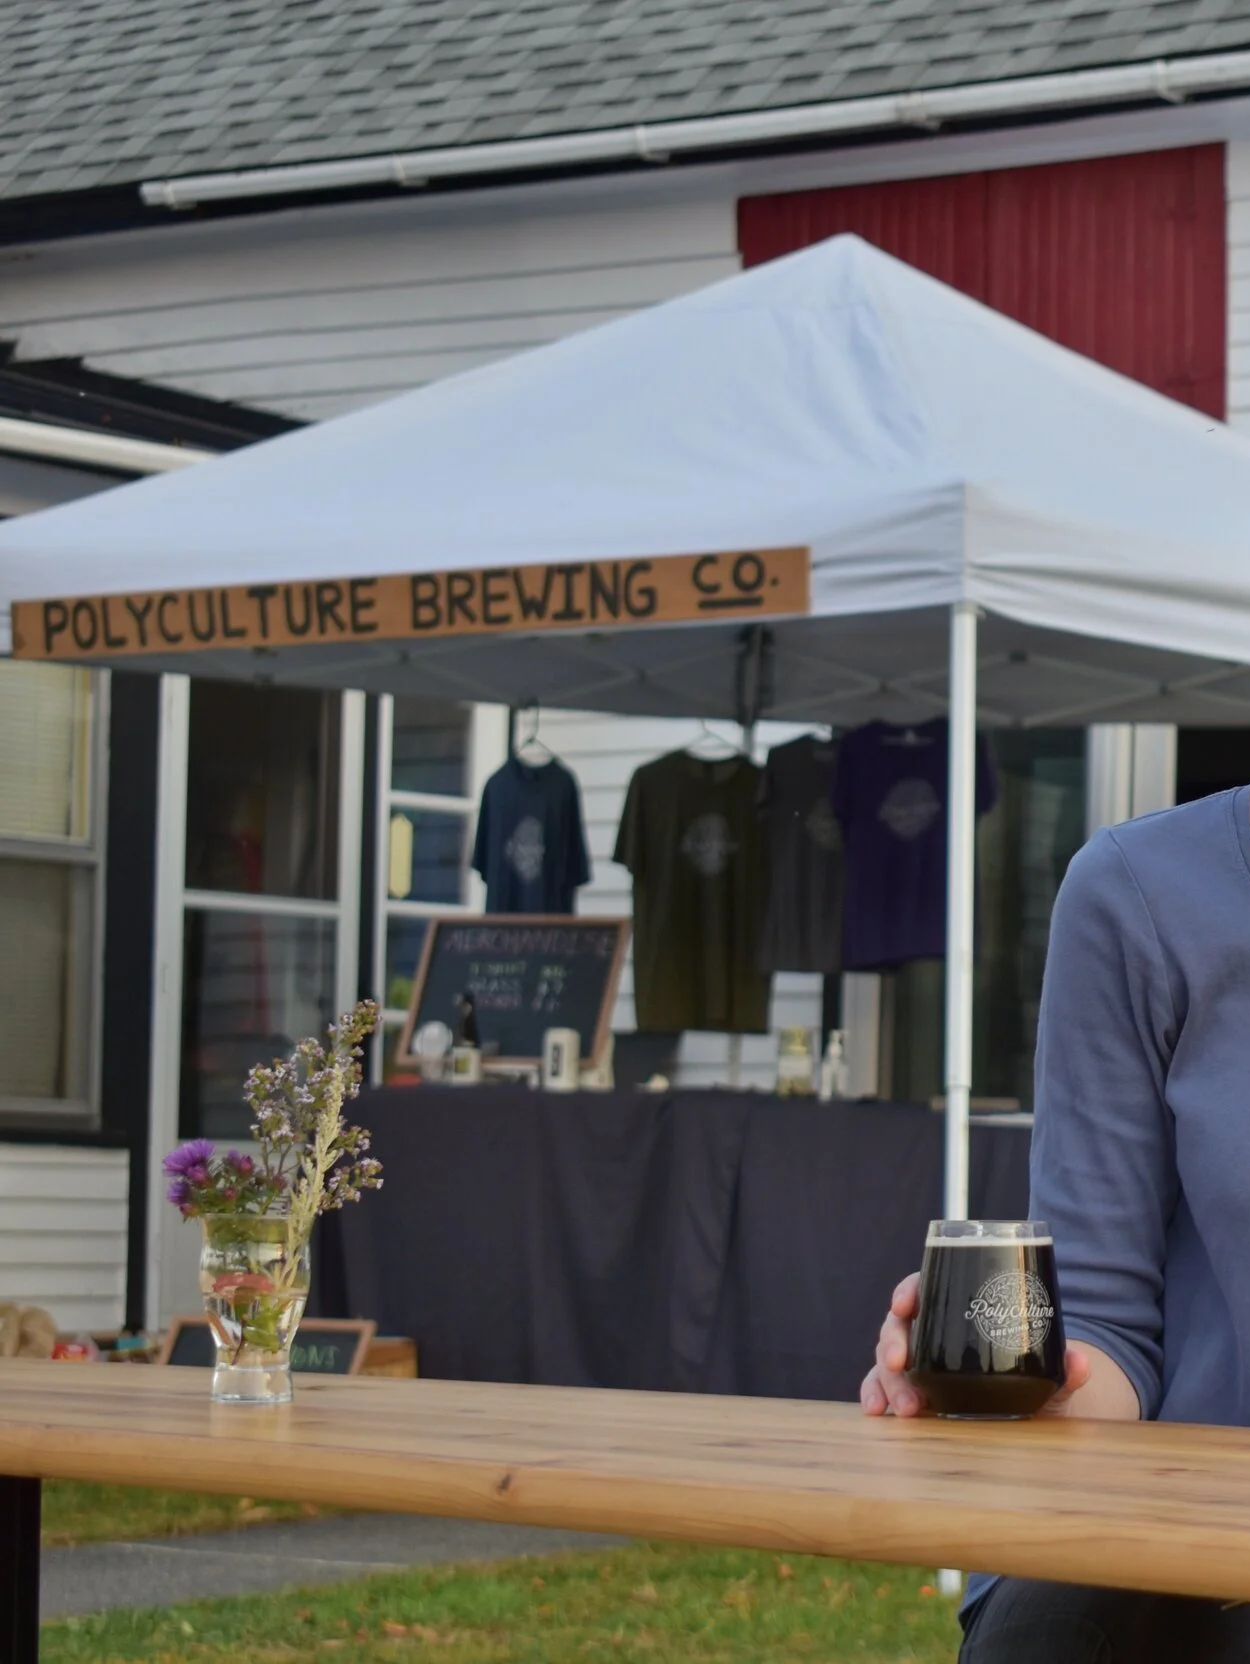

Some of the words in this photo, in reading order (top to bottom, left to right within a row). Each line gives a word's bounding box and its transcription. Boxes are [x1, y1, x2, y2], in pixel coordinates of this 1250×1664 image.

[43, 577, 379, 655] POLYCULTURE
[410, 561, 657, 630] BREWING
[964, 1298, 1055, 1325] PolyCulture
[990, 1324, 1030, 1338] BREWING
